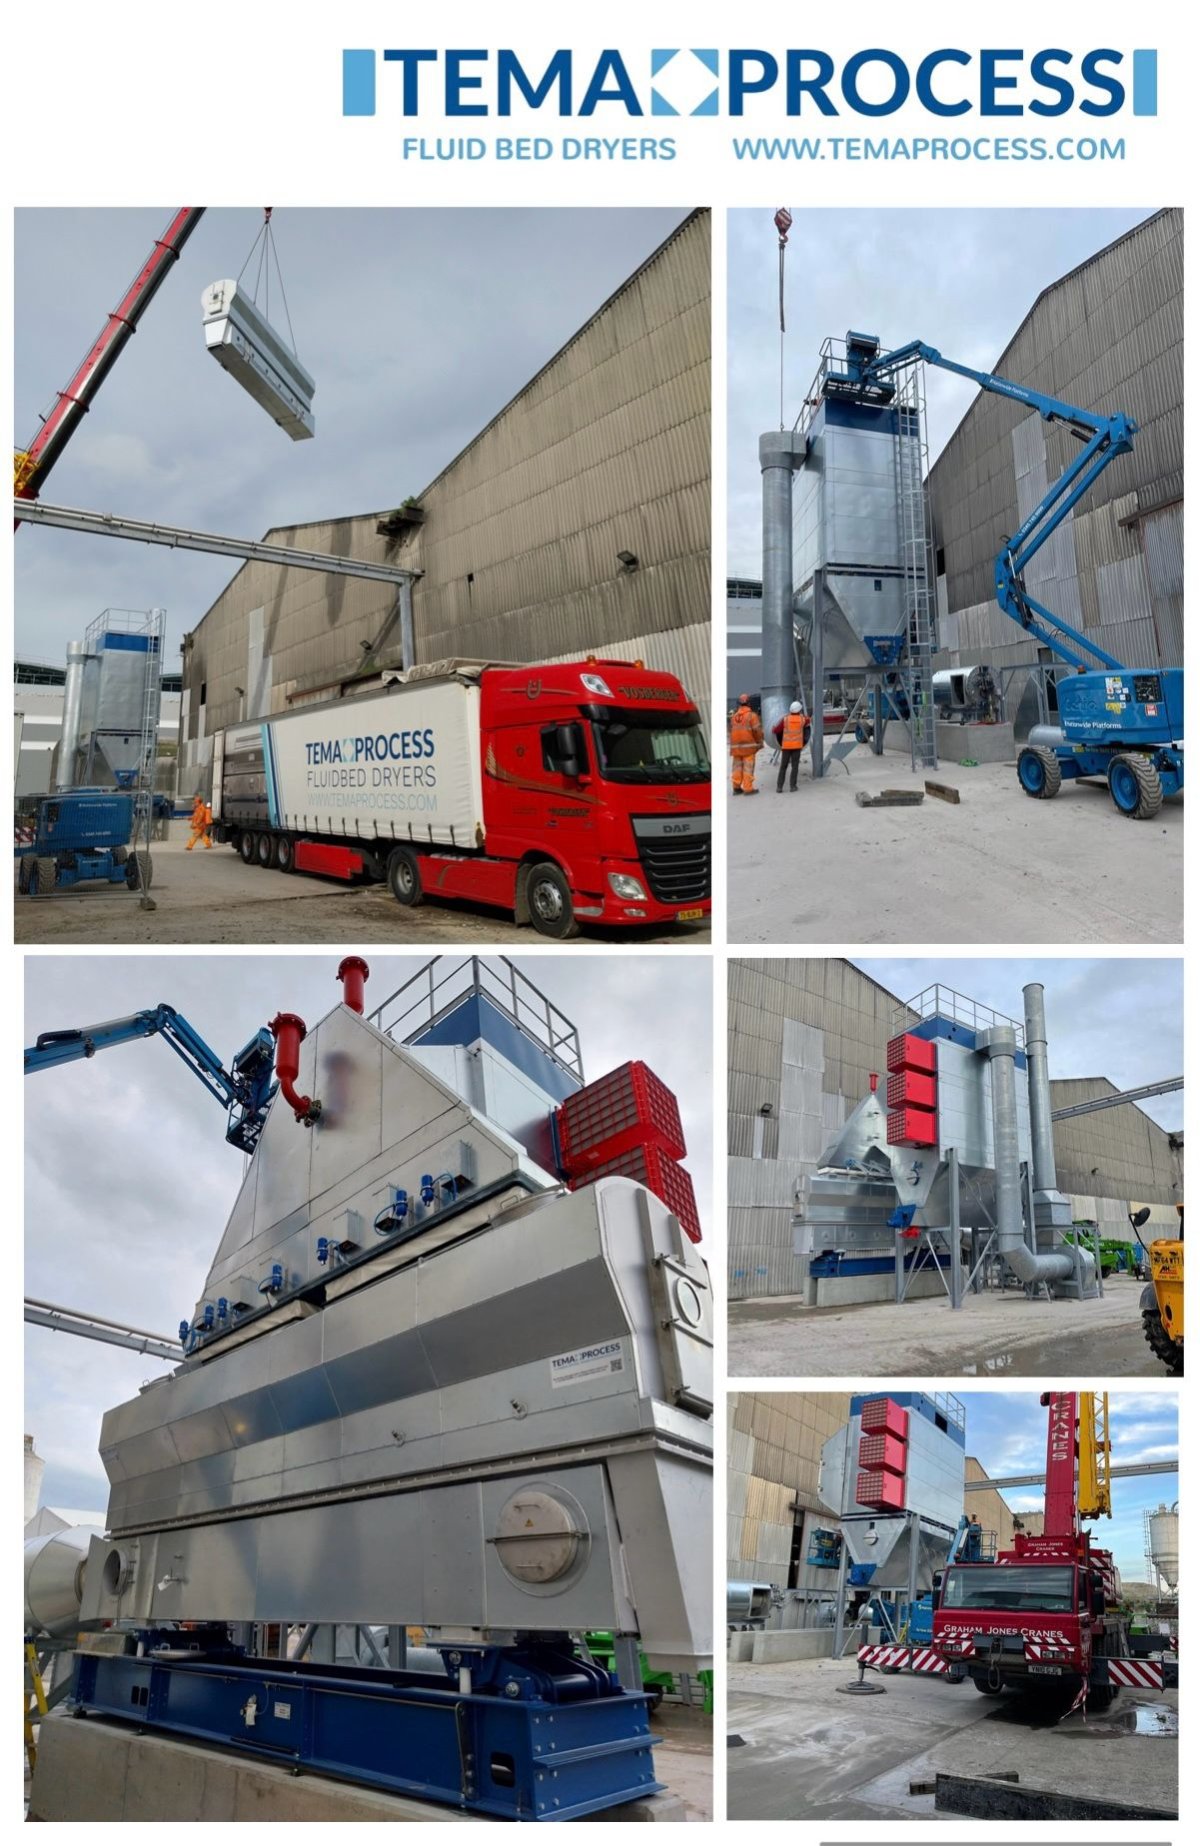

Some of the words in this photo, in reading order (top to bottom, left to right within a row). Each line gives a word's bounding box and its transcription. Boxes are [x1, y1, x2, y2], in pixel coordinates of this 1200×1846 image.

[1092, 721, 1122, 729] Platforms
[305, 740, 342, 765] TEMA
[355, 729, 435, 762] PROCESS
[307, 768, 367, 788] FLUIDBED
[372, 765, 437, 788] DRYERS
[308, 792, 438, 812] WWW.TEMAPROCESS.COM
[663, 824, 691, 834] DAF
[552, 1355, 575, 1368] TEMA
[581, 1342, 621, 1360] PROCESS
[1051, 1400, 1071, 1461] CRANES
[944, 1624, 983, 1634] GRAHAM
[987, 1626, 1018, 1635] JONES
[1020, 1627, 1064, 1638] CRANES
